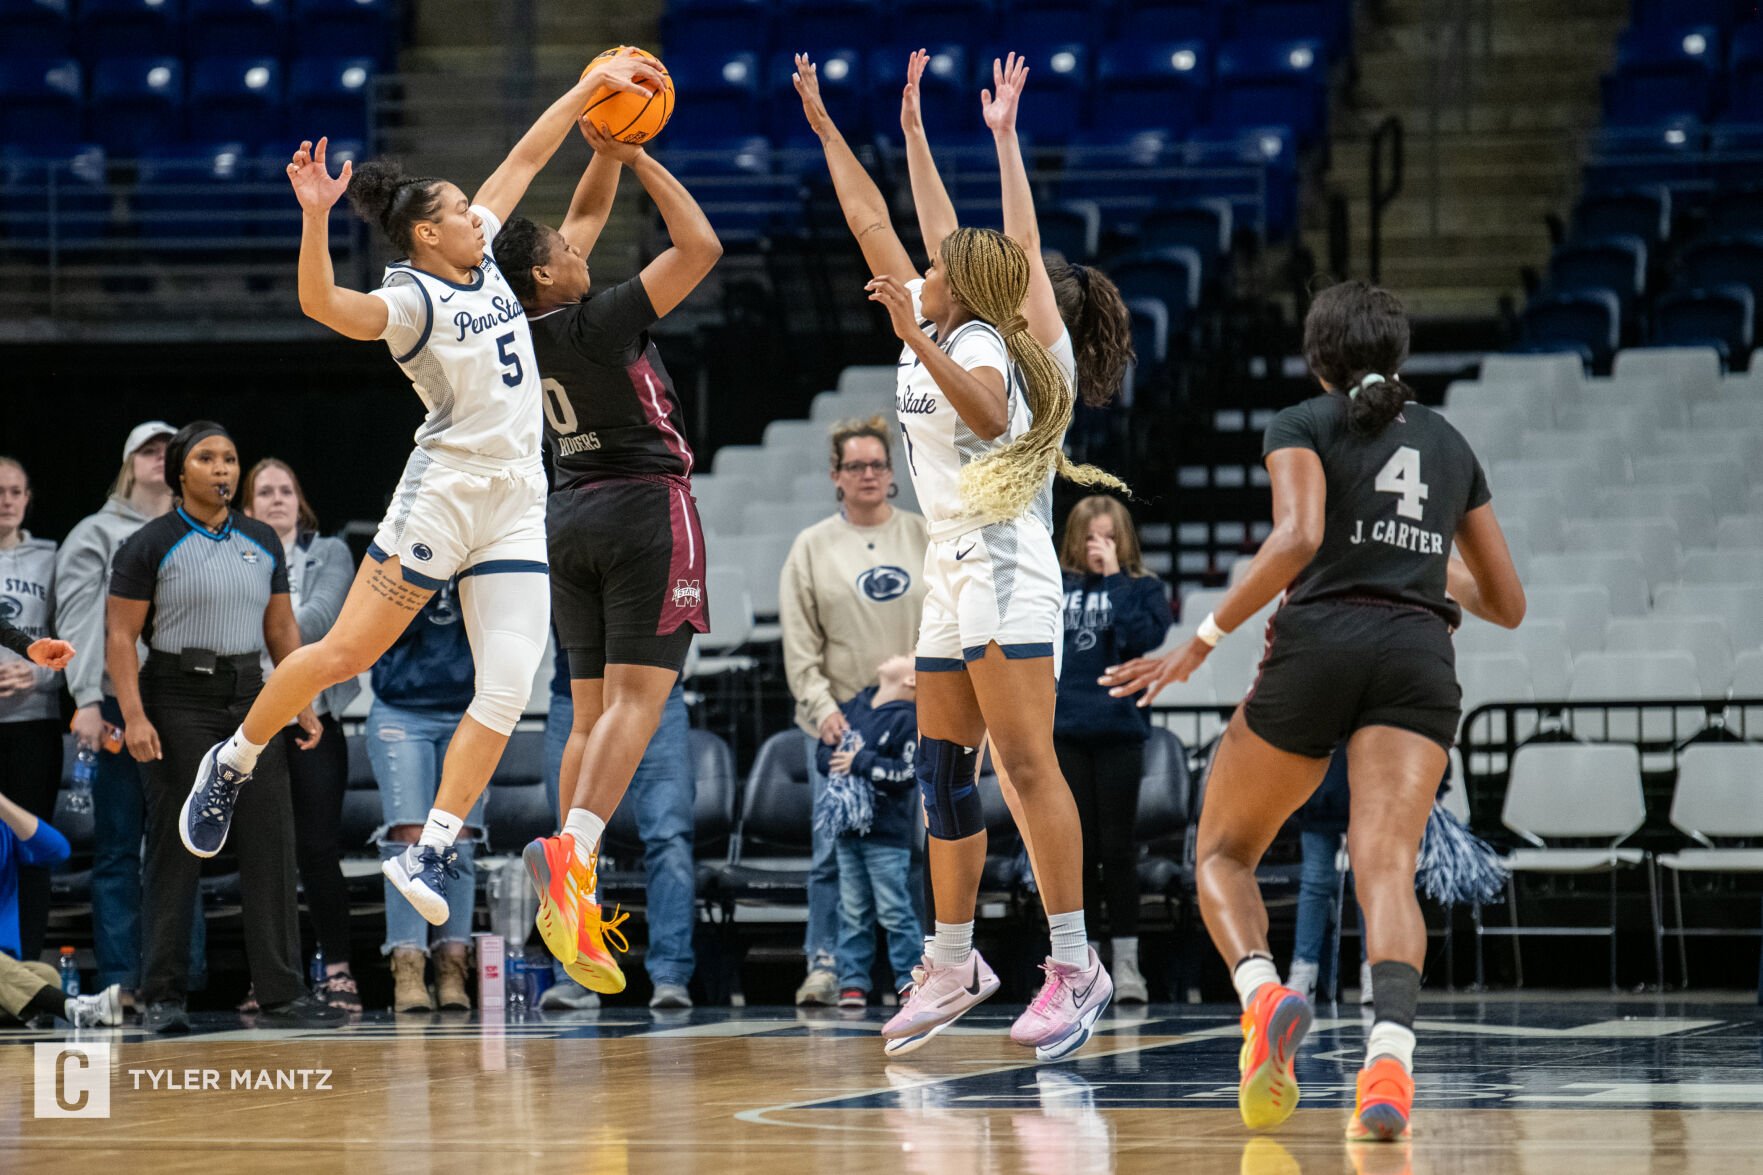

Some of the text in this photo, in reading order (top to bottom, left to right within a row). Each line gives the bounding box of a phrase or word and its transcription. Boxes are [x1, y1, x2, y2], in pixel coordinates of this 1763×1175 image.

[453, 295, 525, 342] Penn Sta
[495, 331, 524, 388] 5
[541, 377, 578, 435] 0
[900, 384, 937, 414] State
[1374, 445, 1429, 521] 4
[1349, 519, 1444, 555] J. CARTER
[5, 577, 46, 602] STATE
